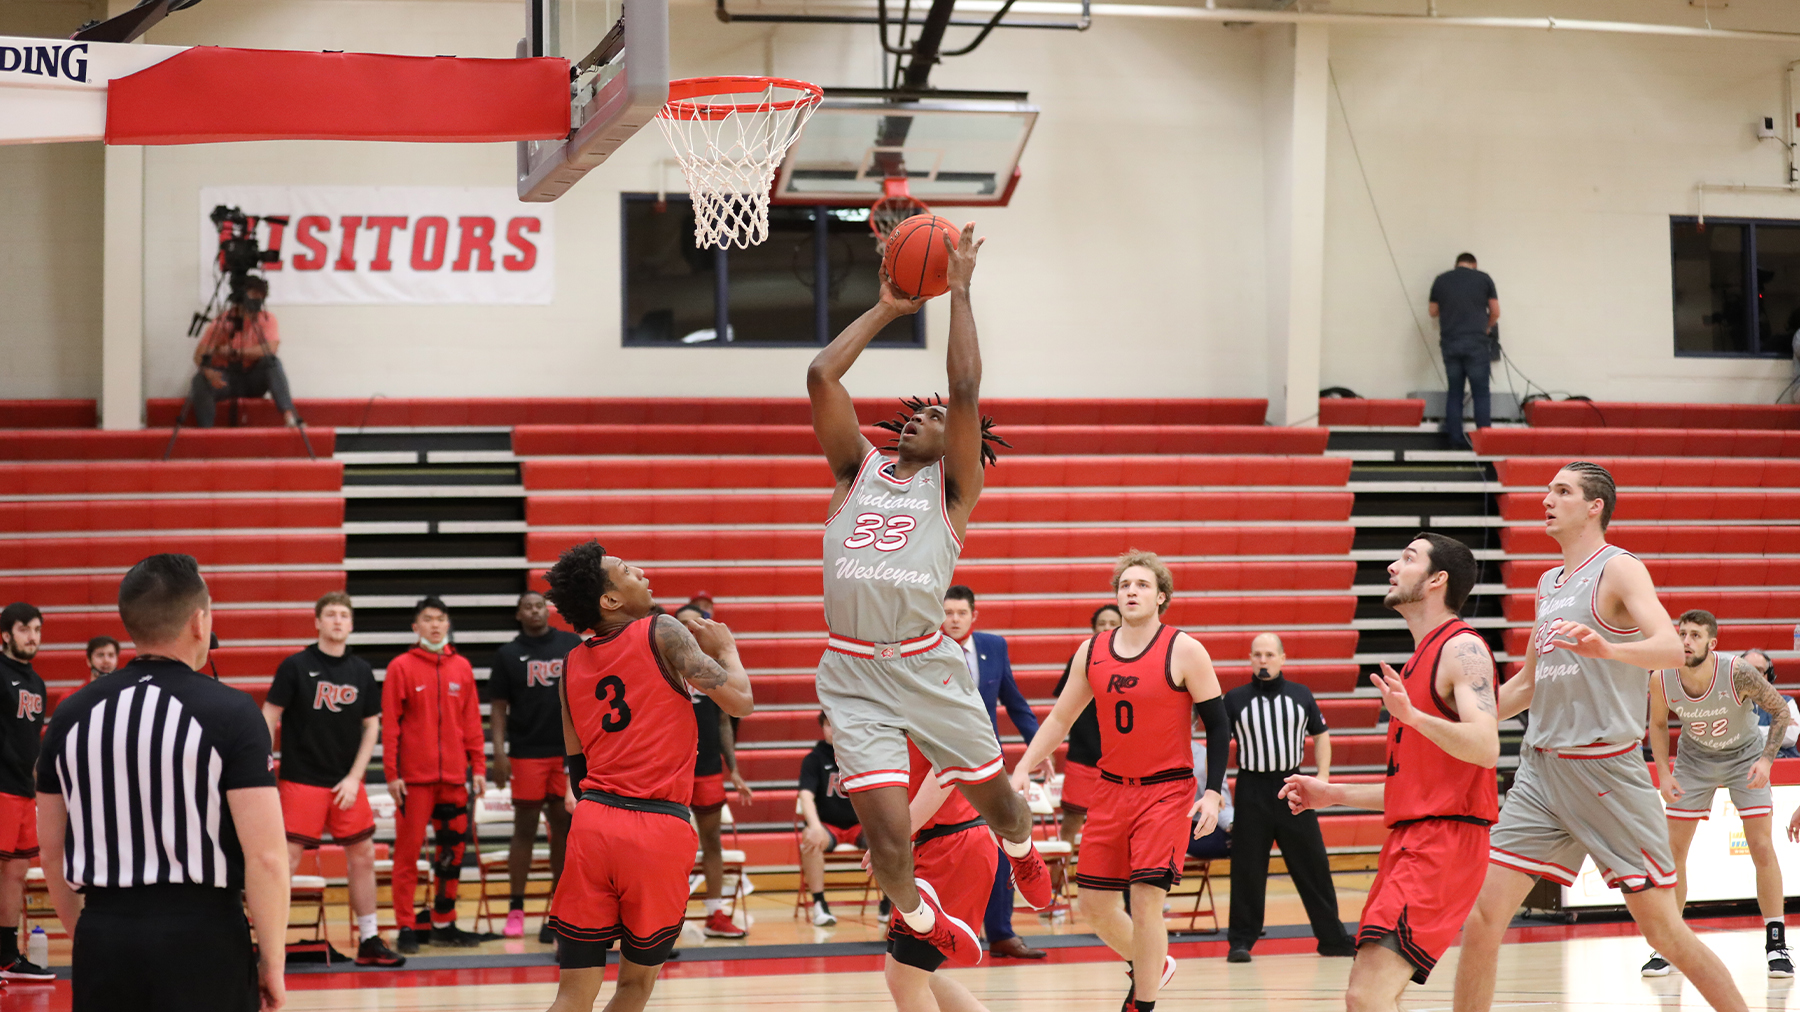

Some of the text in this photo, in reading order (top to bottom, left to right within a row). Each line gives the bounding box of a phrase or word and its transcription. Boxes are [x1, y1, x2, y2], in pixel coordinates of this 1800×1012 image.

[843, 512, 917, 552] 33
[835, 556, 932, 587] Wesleyan
[594, 674, 632, 733] 3
[1115, 700, 1134, 734] 0
[1675, 706, 1729, 718] Indiana
[1689, 718, 1729, 738] 32
